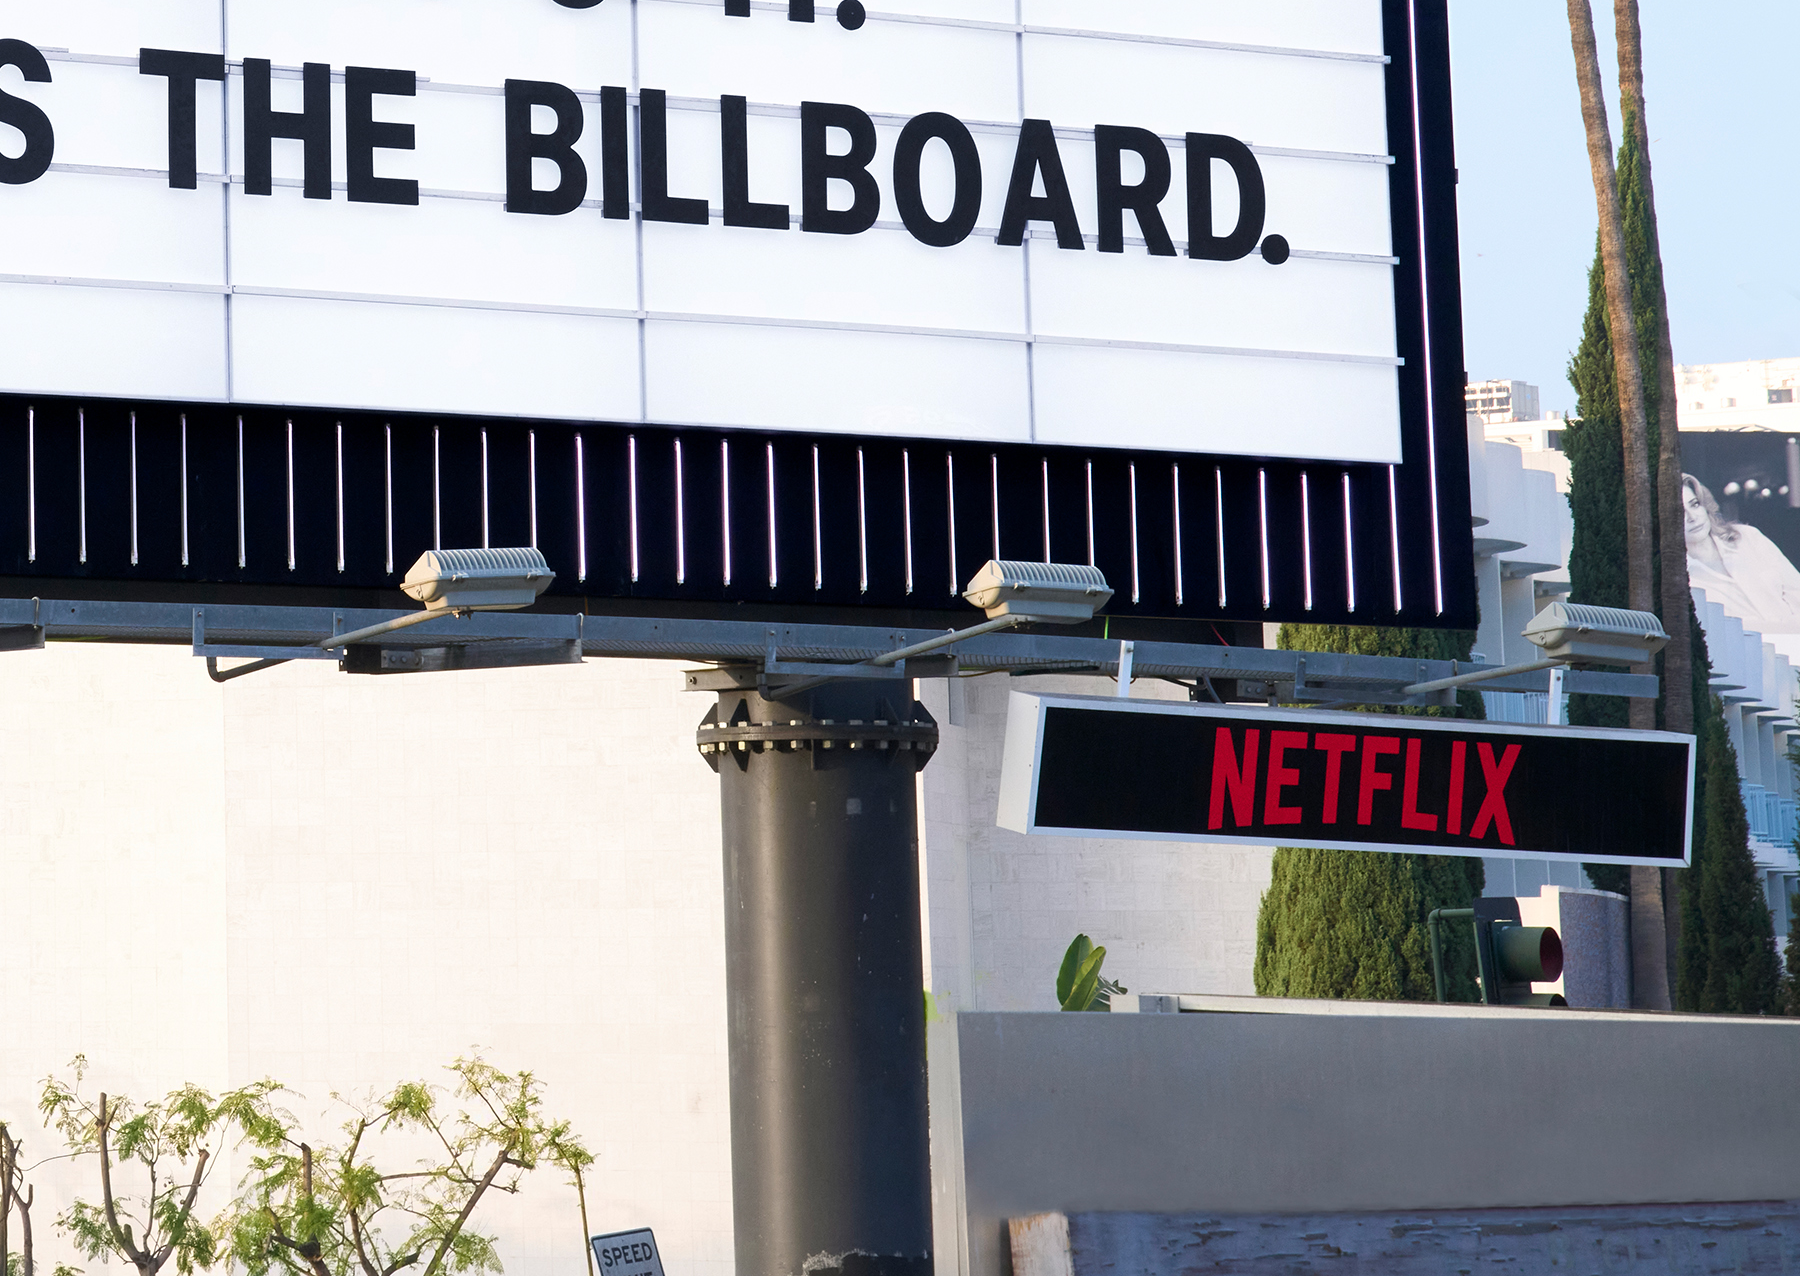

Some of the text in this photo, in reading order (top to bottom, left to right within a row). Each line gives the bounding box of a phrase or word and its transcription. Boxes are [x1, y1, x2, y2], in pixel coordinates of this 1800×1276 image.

[139, 47, 420, 206] THE
[504, 78, 1290, 265] BILLBOARD.
[1207, 726, 1522, 846] NETFLIX
[602, 1242, 653, 1267] SPEED
